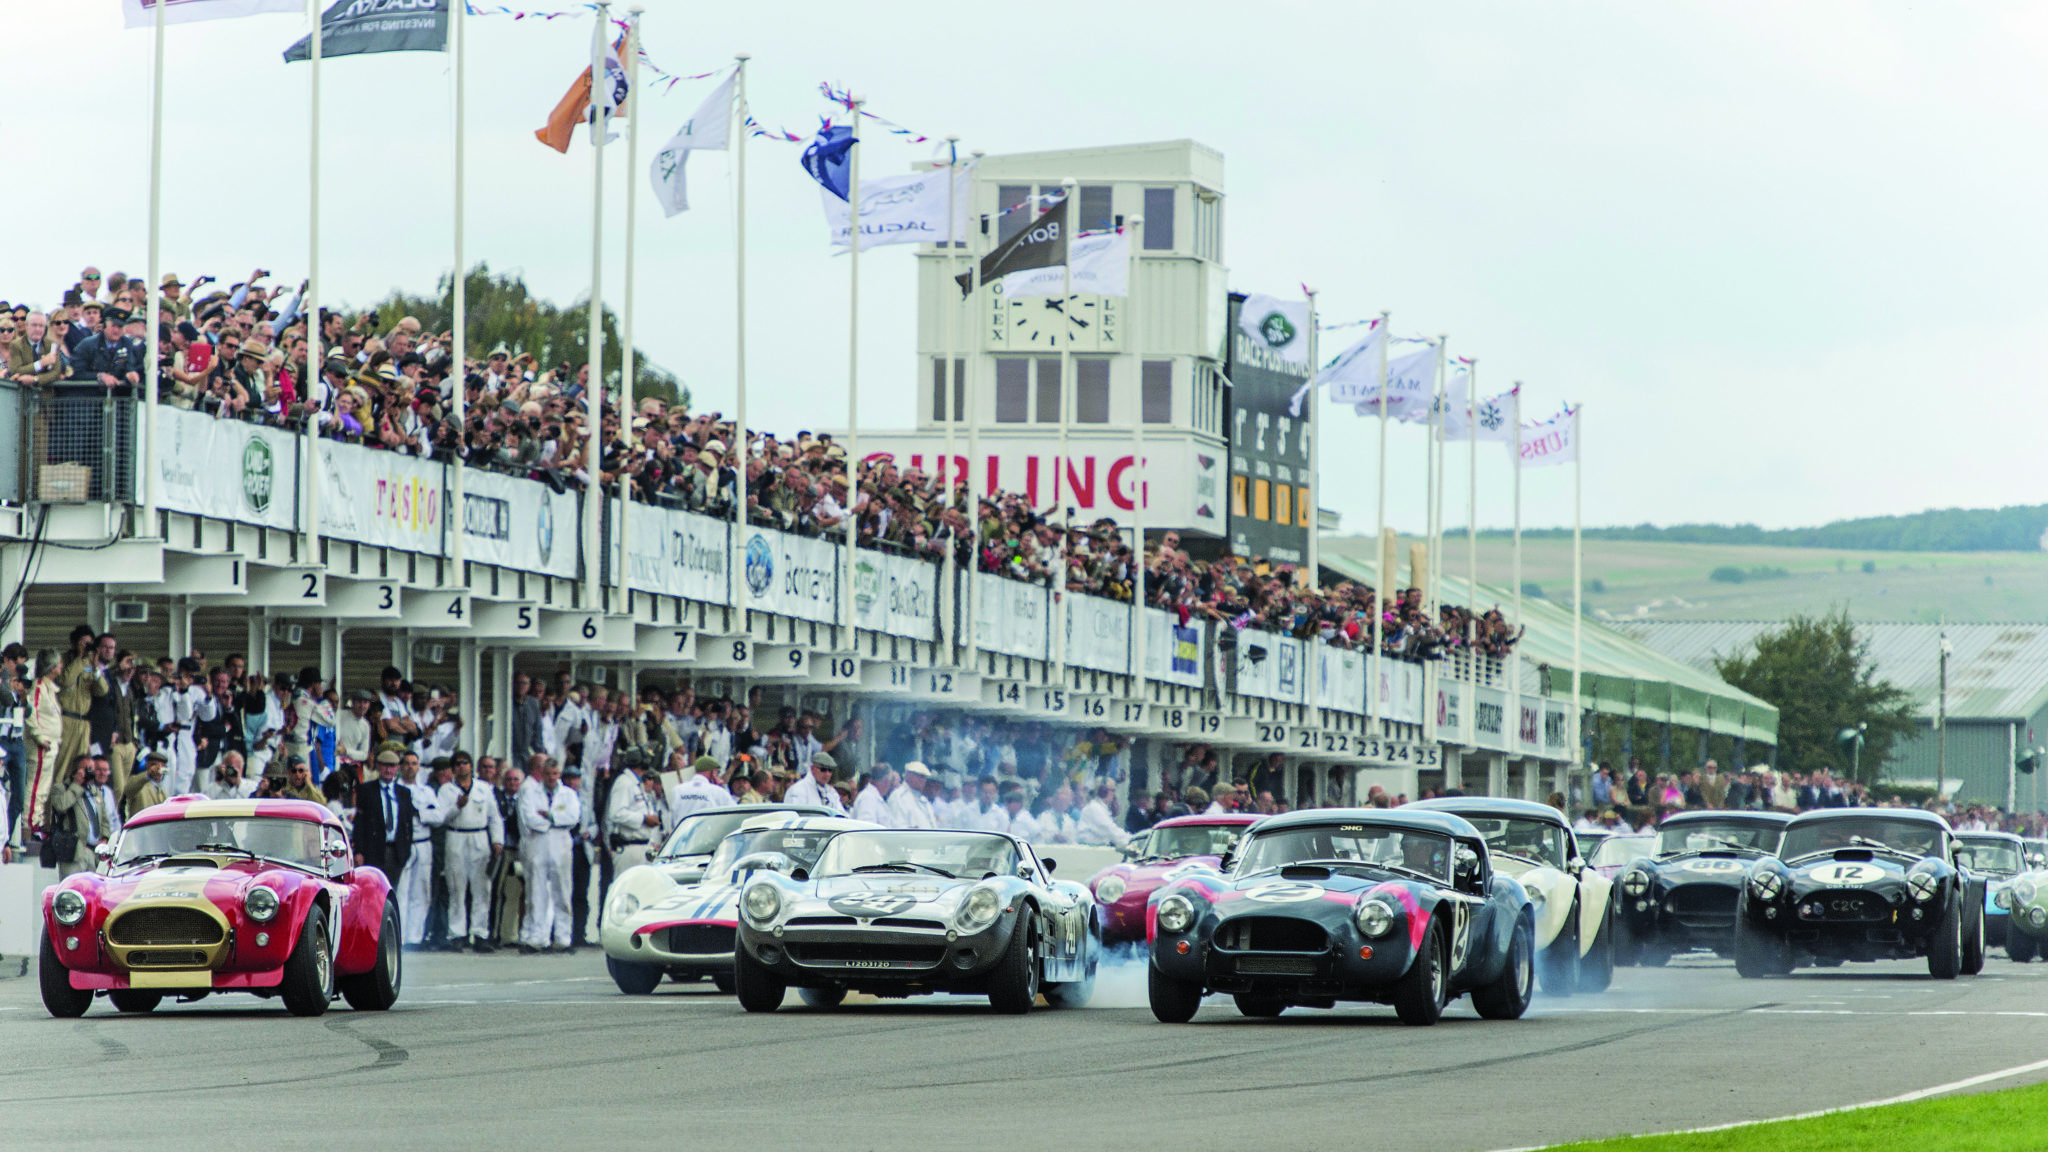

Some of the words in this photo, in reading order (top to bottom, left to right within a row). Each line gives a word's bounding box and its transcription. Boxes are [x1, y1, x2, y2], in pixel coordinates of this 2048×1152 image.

[992, 283, 1004, 341] OLEX
[377, 479, 437, 525] TESCO
[233, 560, 240, 586] 1
[302, 573, 318, 598] 2
[378, 585, 393, 610] 3
[447, 597, 463, 620] 4
[517, 607, 532, 630] 5
[582, 610, 597, 639] 6
[674, 632, 688, 652] 7
[732, 640, 747, 662] 8
[788, 649, 802, 669] 9
[831, 658, 855, 678] 10
[890, 665, 906, 686] 11
[930, 673, 953, 693] 12
[998, 682, 1021, 704] 14
[1044, 690, 1065, 712] 15
[1084, 698, 1105, 717] 16
[1124, 703, 1144, 722] 17
[1163, 709, 1183, 728] 18
[1200, 715, 1220, 733] 19
[1260, 725, 1285, 742] 20
[1300, 731, 1318, 748] 21
[1324, 735, 1348, 752] 22
[1357, 741, 1380, 757] 23
[1386, 745, 1409, 761] 24
[1415, 750, 1437, 765] 25
[1834, 867, 1864, 878] 12
